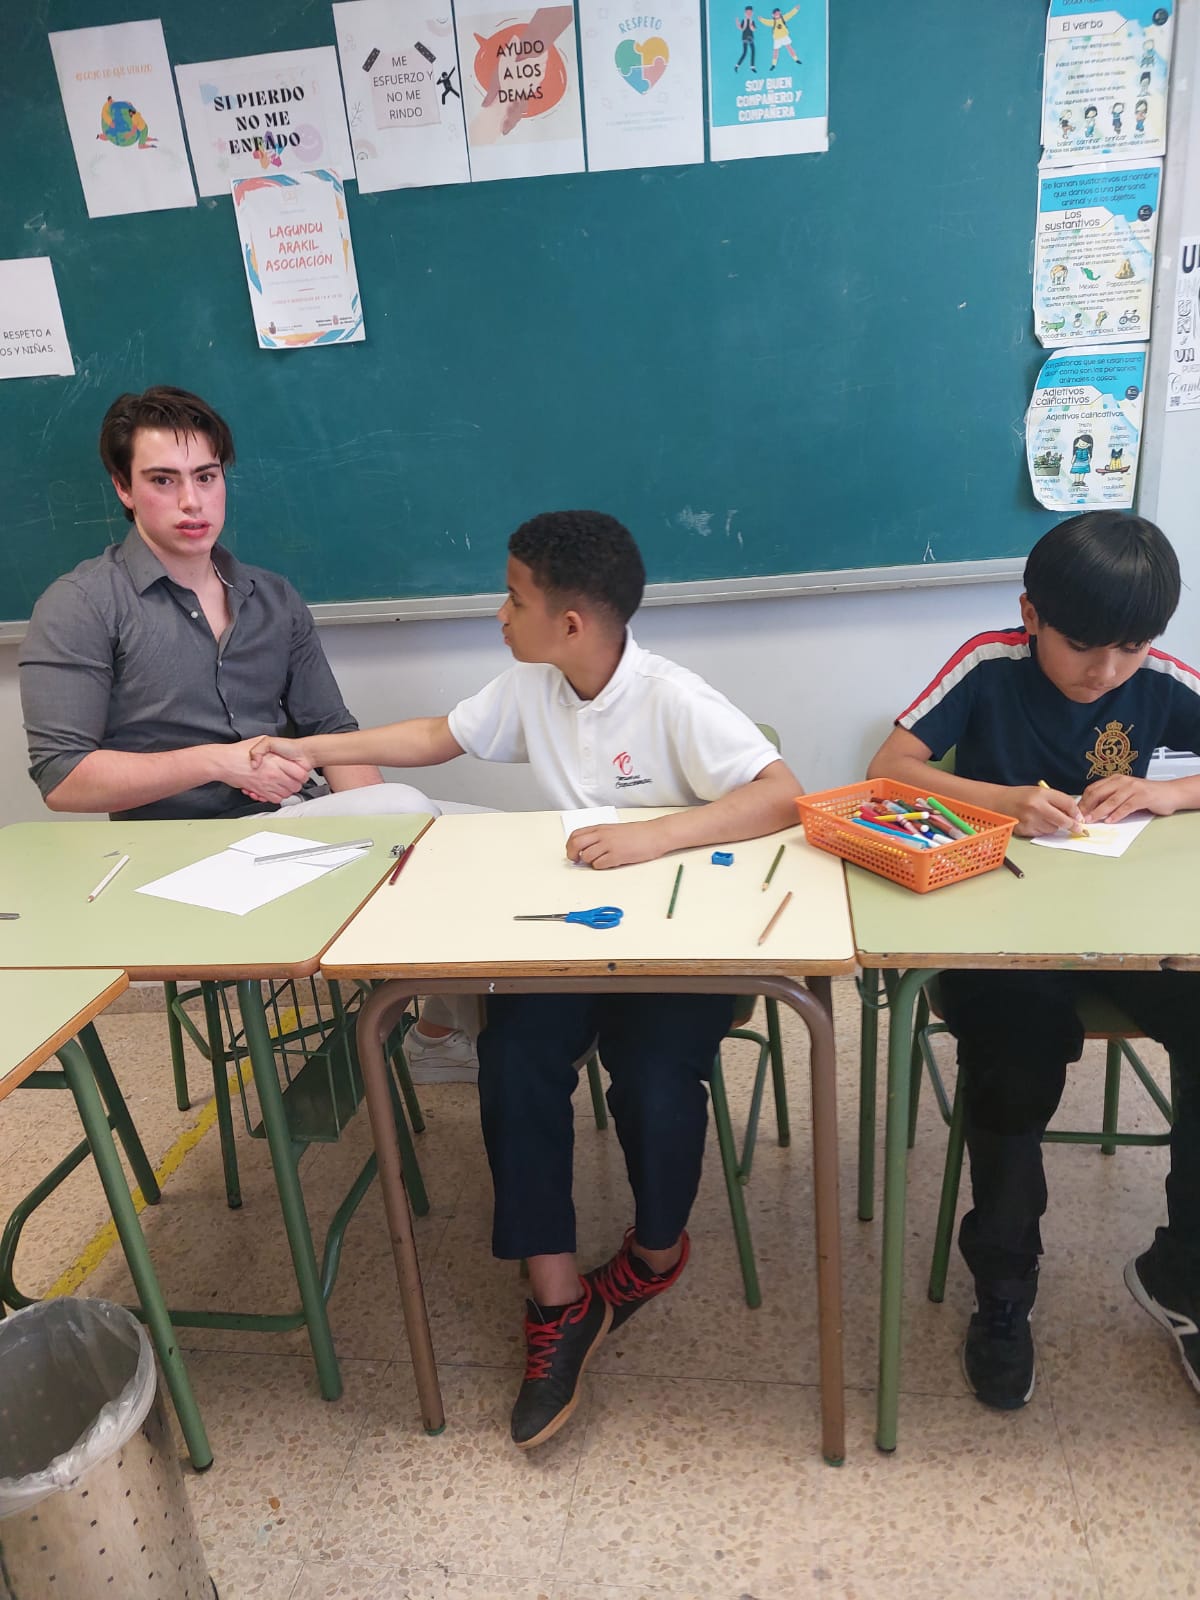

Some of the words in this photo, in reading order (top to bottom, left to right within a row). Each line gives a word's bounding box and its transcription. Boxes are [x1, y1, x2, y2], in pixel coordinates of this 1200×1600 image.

[618, 16, 664, 34] RESPETO
[1062, 22, 1070, 32] El
[1074, 19, 1104, 31] verbo
[496, 40, 545, 58] AYUDO
[391, 55, 408, 68] ME
[373, 71, 426, 88] ESFUERZO
[427, 70, 434, 82] Y
[503, 66, 515, 80] A
[516, 63, 543, 79] LOS
[745, 79, 765, 92] SOY
[766, 76, 793, 90] BUEN
[213, 95, 232, 112] SI
[236, 86, 305, 109] PIERDO
[386, 91, 403, 103] NO
[405, 89, 422, 101] ME
[498, 83, 545, 104] DEMÁS
[736, 89, 795, 108] COMPAÑERO
[795, 89, 803, 103] Y
[389, 107, 424, 121] RINDO
[738, 104, 796, 122] COMPAÑERA
[235, 114, 261, 132] NO
[264, 111, 291, 128] ME
[229, 131, 301, 155] ENFADO
[1064, 210, 1081, 219] Los
[269, 222, 323, 239] LAGUNDU
[1044, 218, 1101, 231] sustantivos
[278, 239, 320, 255] ARAKIL
[266, 251, 333, 272] ASOCIACIÓN
[1182, 244, 1200, 273] U
[3, 329, 43, 340] RESPETO
[45, 329, 52, 337] A
[14, 346, 20, 356] Y
[22, 342, 56, 355] NIÑAS.
[1043, 387, 1085, 397] Adjetivos
[1035, 396, 1090, 405] Calificativos
[1046, 411, 1080, 422] Adjetivos
[1081, 410, 1125, 420] Calificativos
